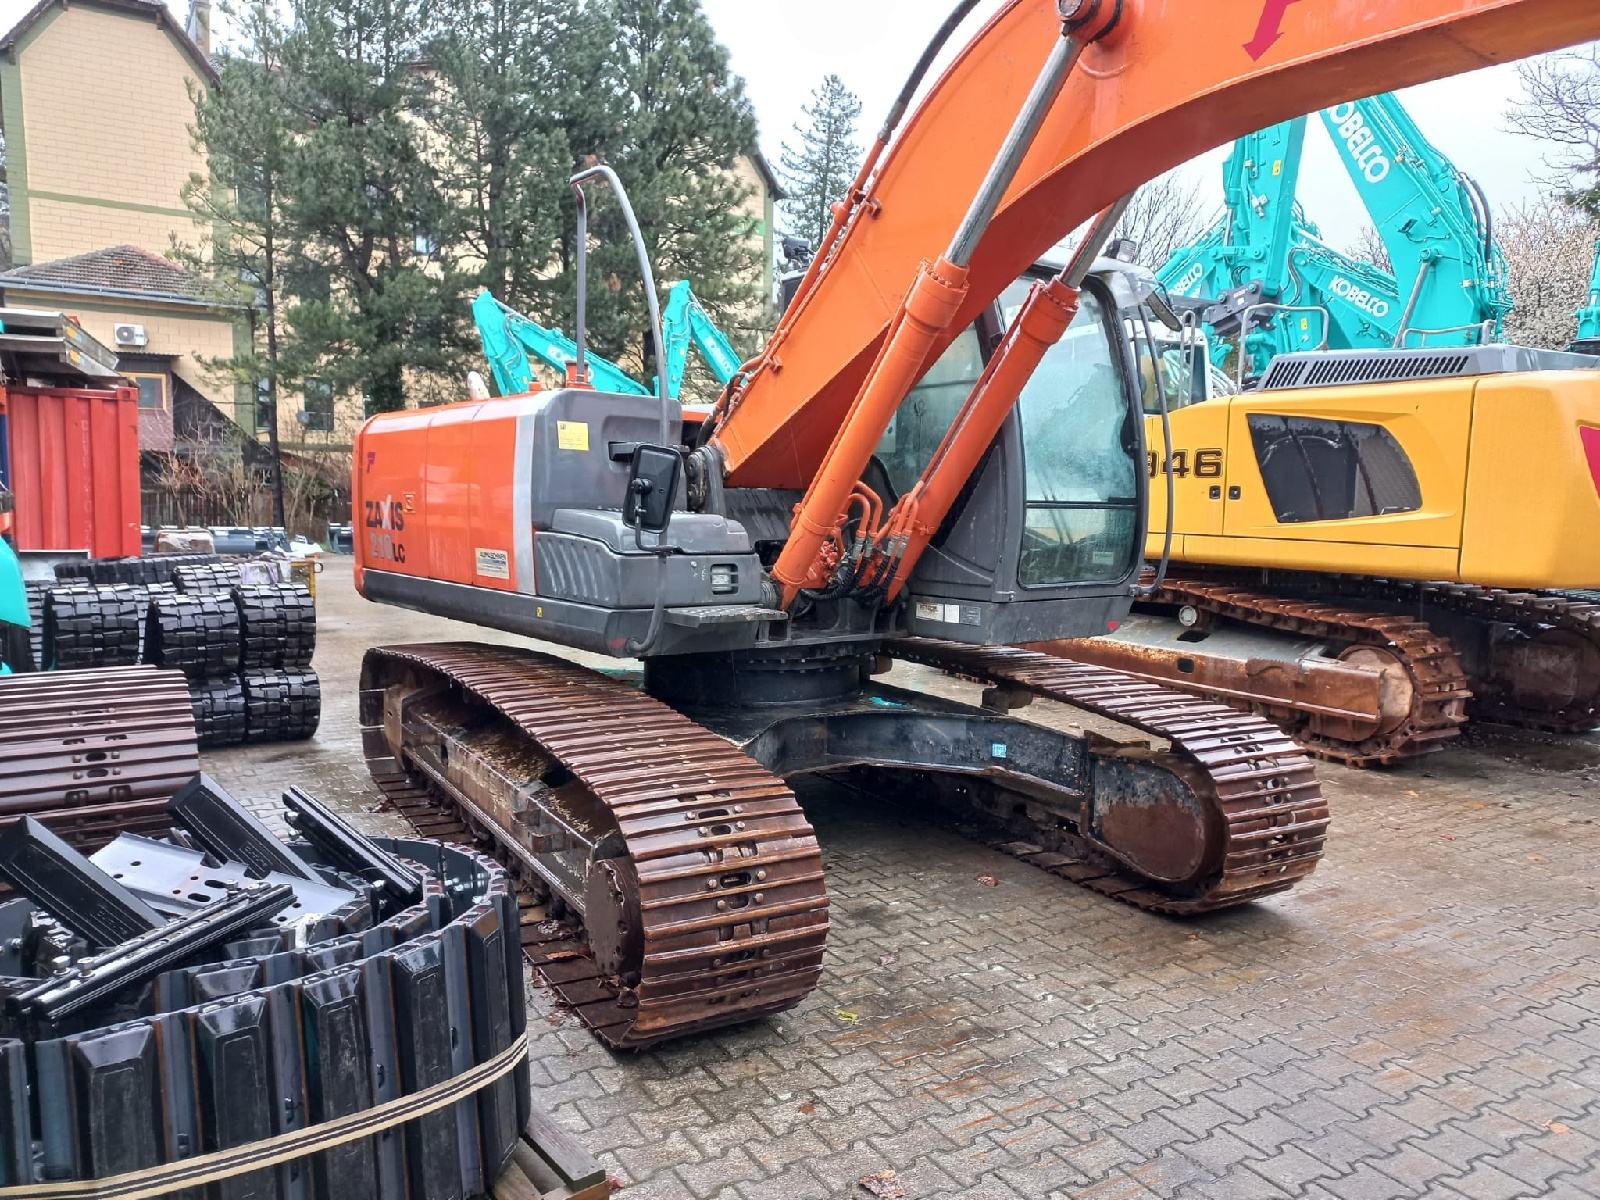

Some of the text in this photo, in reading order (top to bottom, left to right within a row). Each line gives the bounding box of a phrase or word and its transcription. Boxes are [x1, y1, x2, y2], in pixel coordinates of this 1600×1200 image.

[1328, 101, 1390, 183] OBELCO
[1167, 262, 1203, 295] BELCO
[1328, 274, 1389, 317] KOBELCO
[365, 494, 404, 531] ZAXIS
